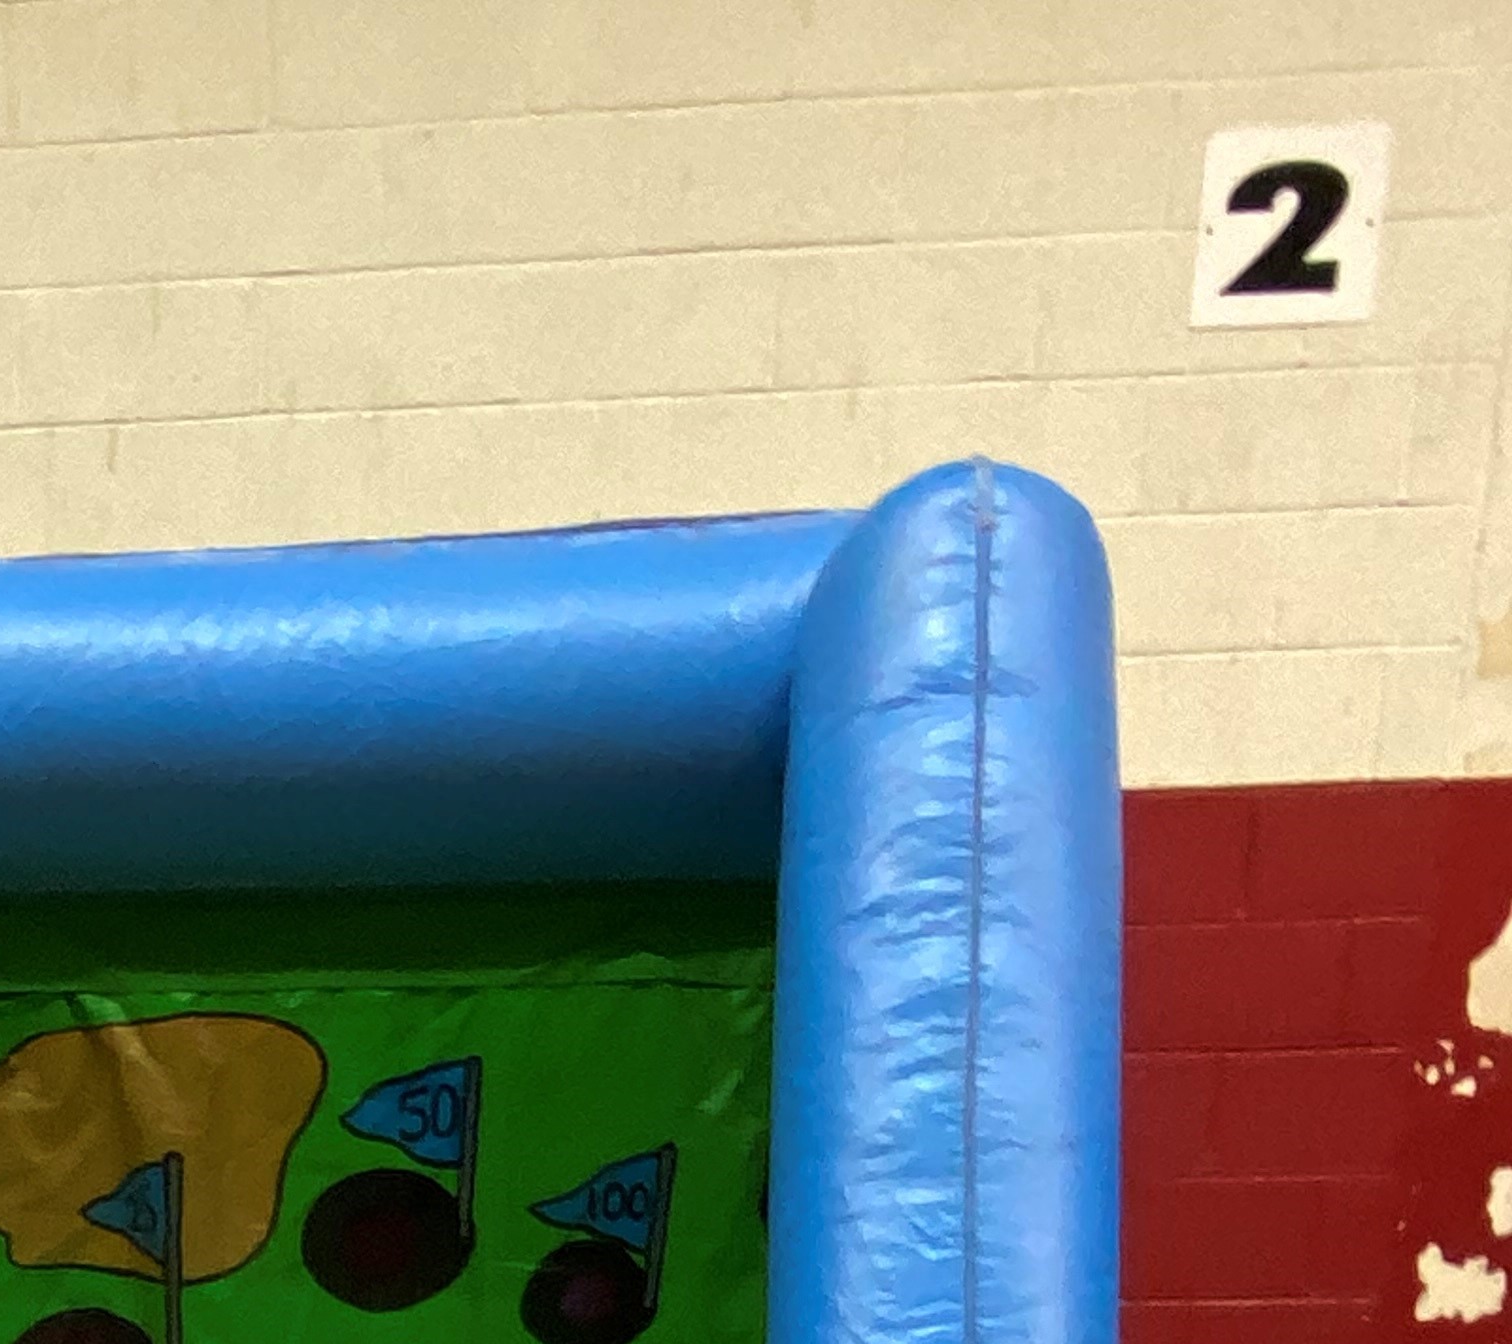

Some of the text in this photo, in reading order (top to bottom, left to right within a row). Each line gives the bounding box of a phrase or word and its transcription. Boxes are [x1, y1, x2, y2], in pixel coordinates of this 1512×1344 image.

[1219, 160, 1348, 297] 2
[399, 1084, 459, 1142] 50
[588, 1181, 653, 1222] 100
